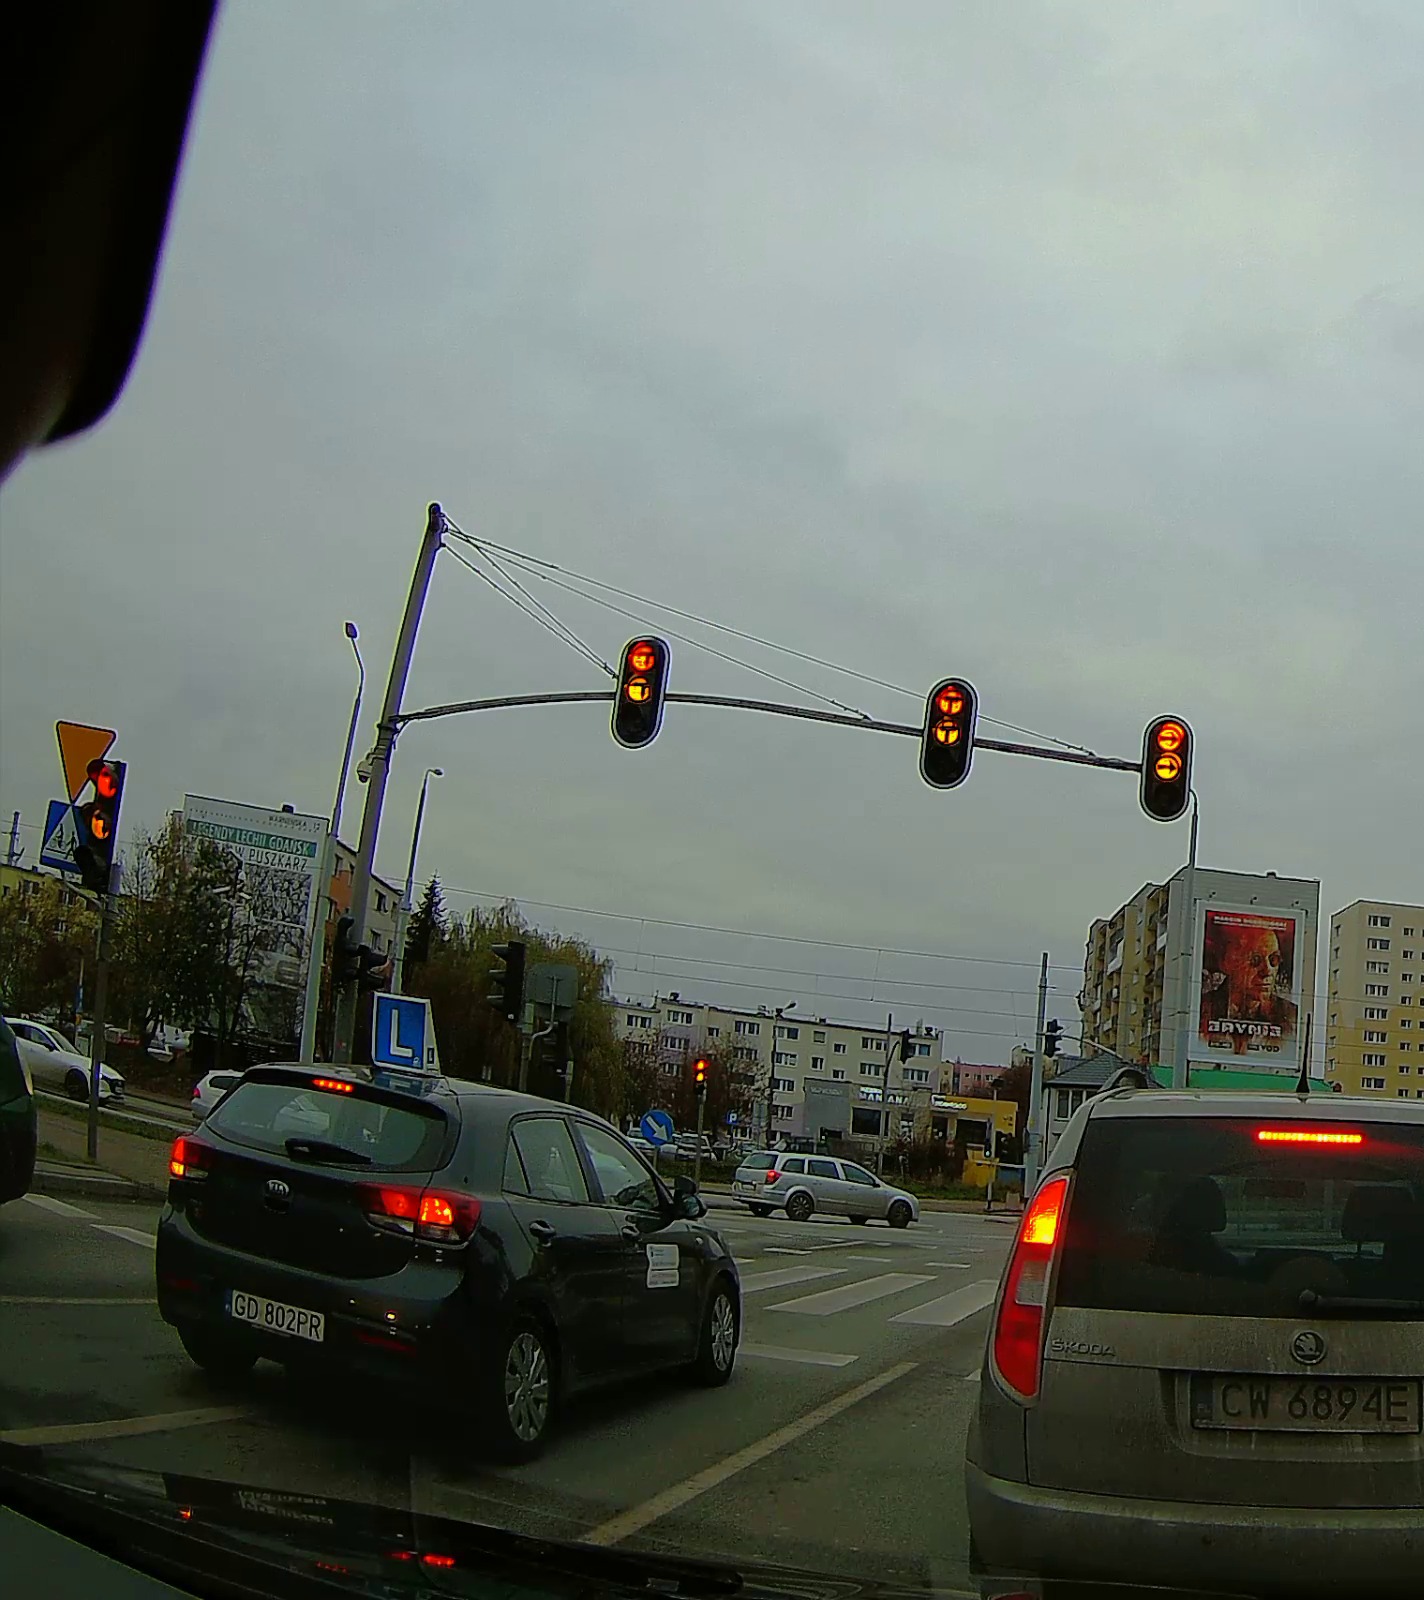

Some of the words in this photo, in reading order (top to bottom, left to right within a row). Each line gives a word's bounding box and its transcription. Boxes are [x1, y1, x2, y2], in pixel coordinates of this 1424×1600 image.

[192, 822, 234, 841] LEGENDY
[236, 828, 267, 847] LECHII
[248, 848, 308, 872] PUSZKARZ
[390, 1008, 413, 1058] L
[235, 1293, 259, 1320] GD
[264, 1302, 321, 1340] 802PR
[1221, 1383, 1271, 1420] CW
[1287, 1384, 1409, 1422] 6894E
